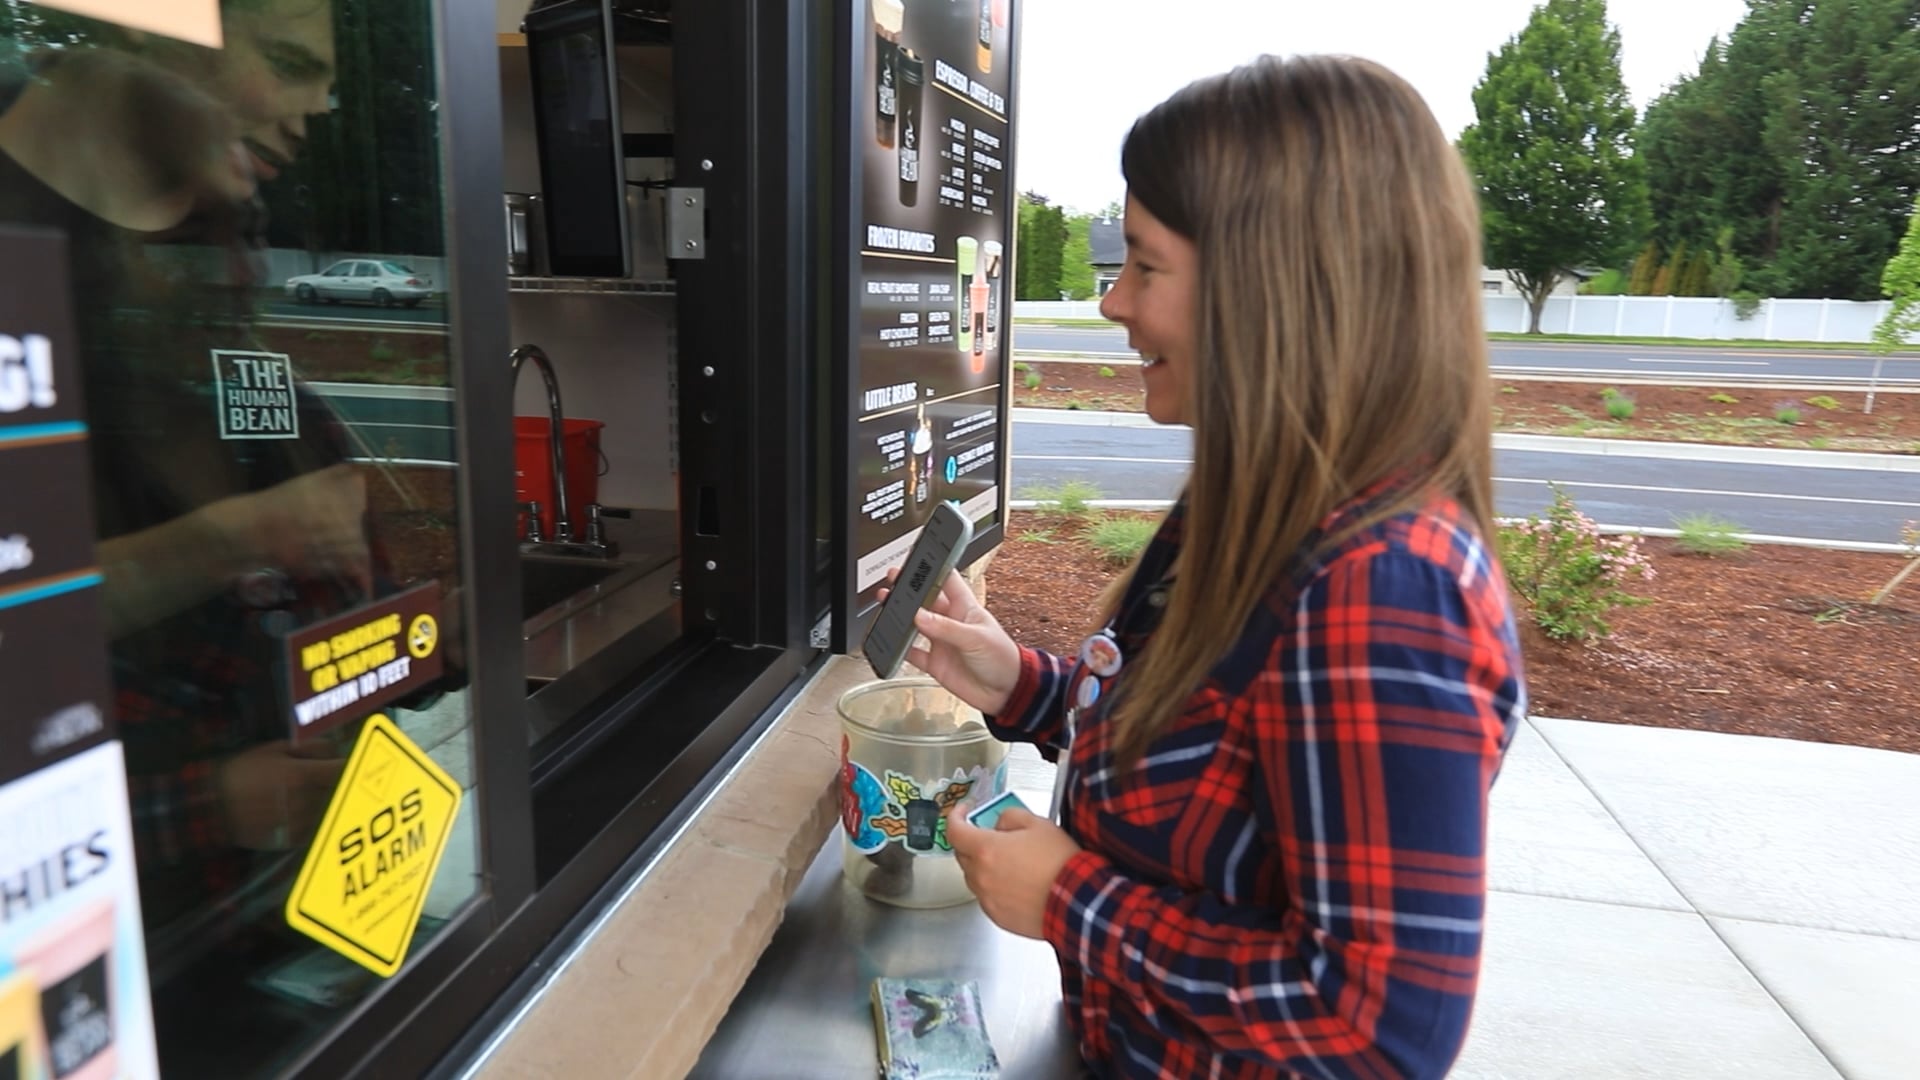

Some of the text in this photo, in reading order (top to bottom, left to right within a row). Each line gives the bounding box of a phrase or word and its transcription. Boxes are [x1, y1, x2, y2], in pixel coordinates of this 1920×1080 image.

[868, 225, 898, 248] FROZEN
[232, 360, 286, 389] THE
[228, 390, 289, 406] HUMAN
[865, 383, 917, 411] LITTLE BEANS
[230, 407, 290, 430] BEAN
[302, 613, 402, 672] NO SMOKING
[312, 640, 396, 692] OR VAPING
[294, 656, 411, 726] WITHIN 10 FEET
[340, 788, 422, 866] SOS
[342, 822, 426, 906] ALARM
